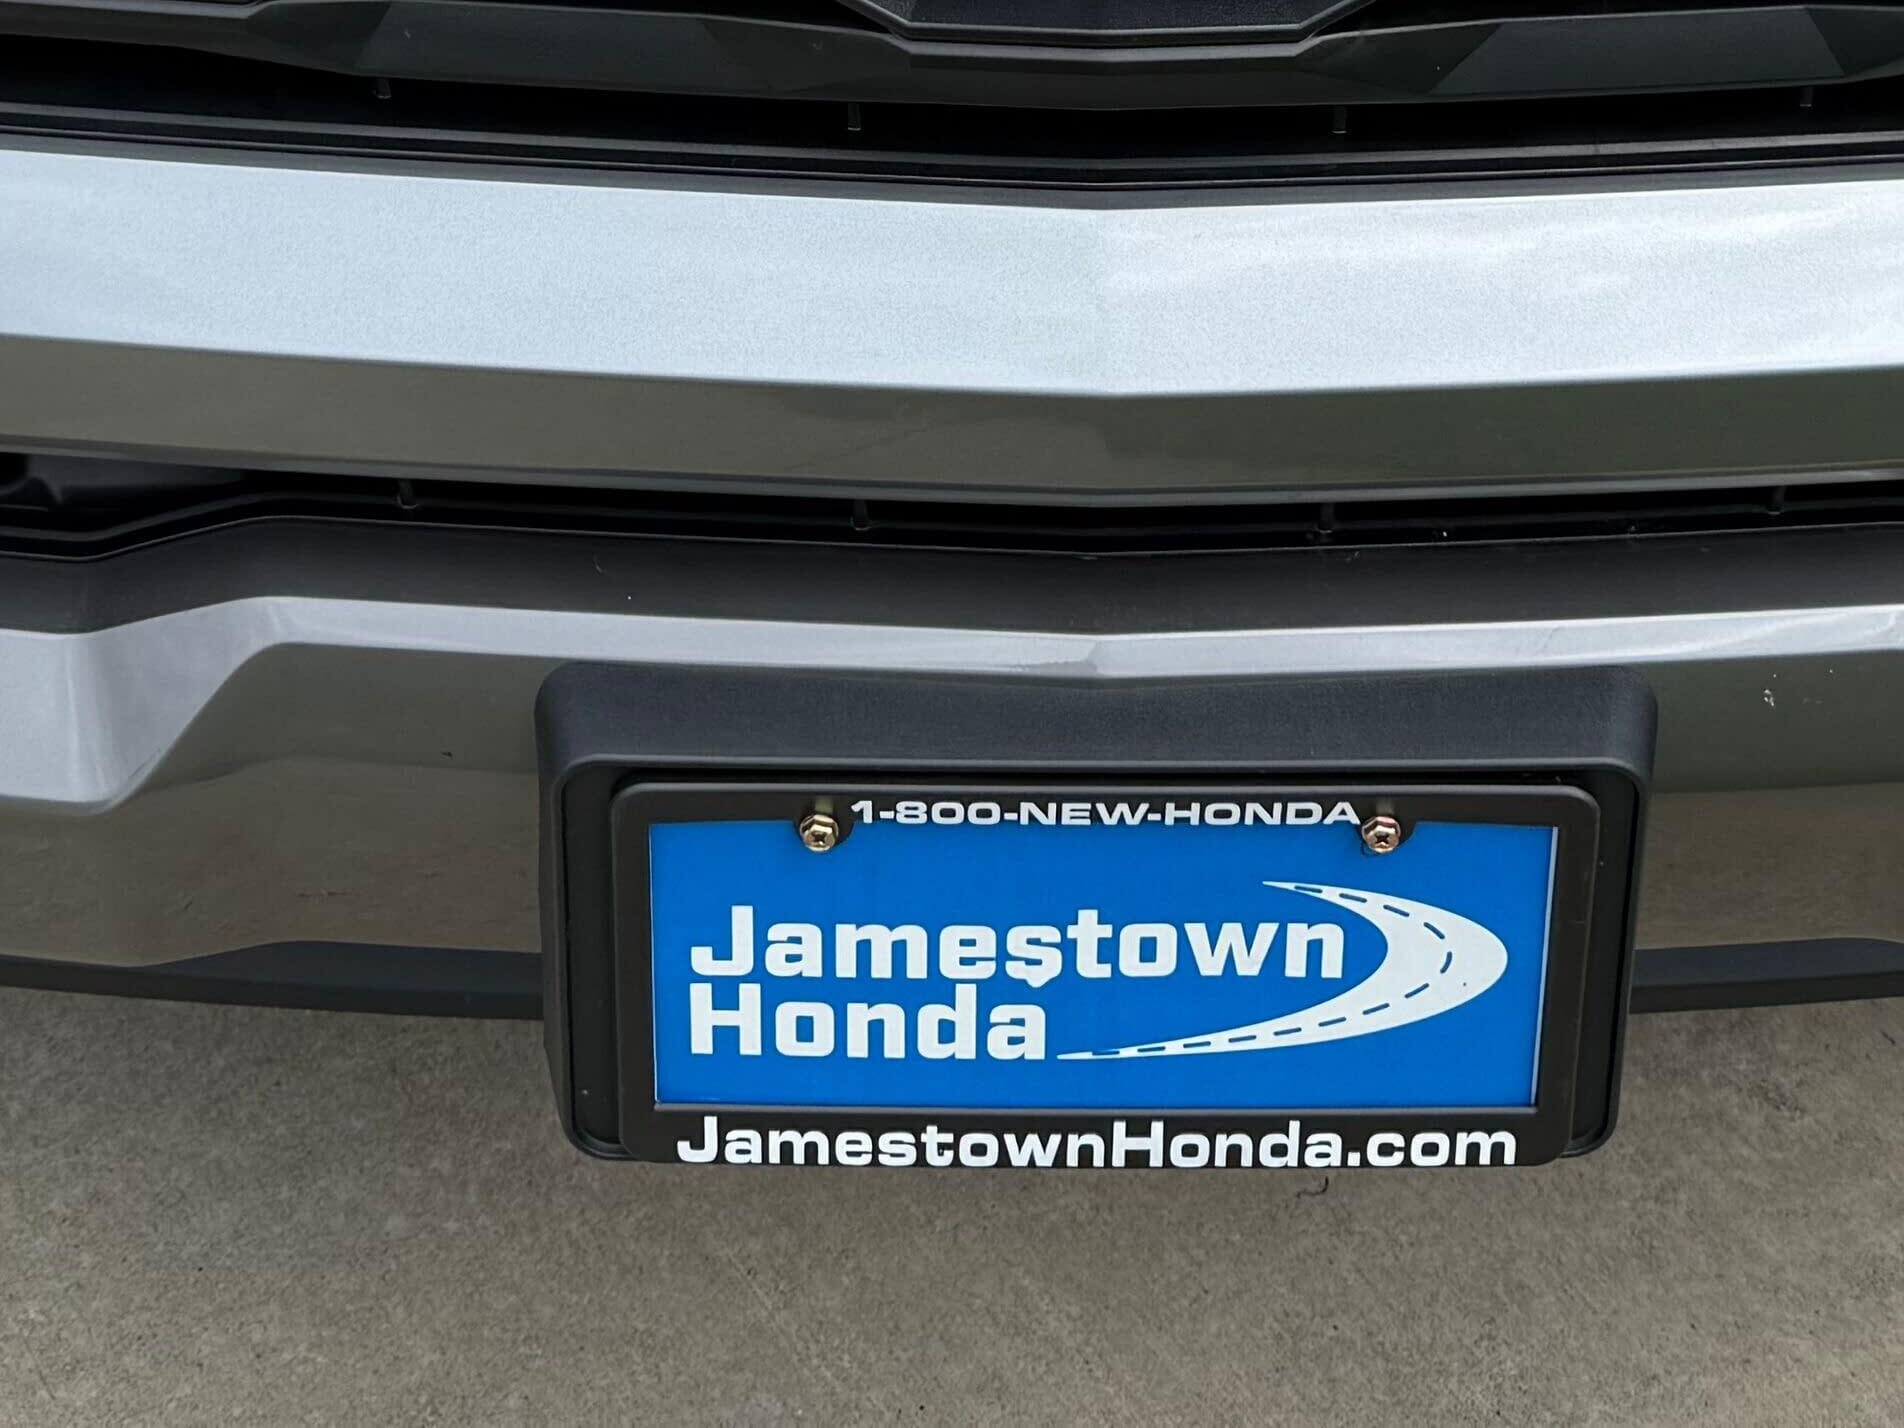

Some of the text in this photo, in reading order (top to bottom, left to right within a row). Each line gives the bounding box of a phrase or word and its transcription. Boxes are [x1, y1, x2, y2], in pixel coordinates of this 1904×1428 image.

[850, 799, 1361, 827] 1-800-NEW-HONDA
[690, 904, 1345, 982] Jamestown
[689, 982, 1046, 1061] Honda
[676, 1114, 1518, 1169] JamestownHonda.com
